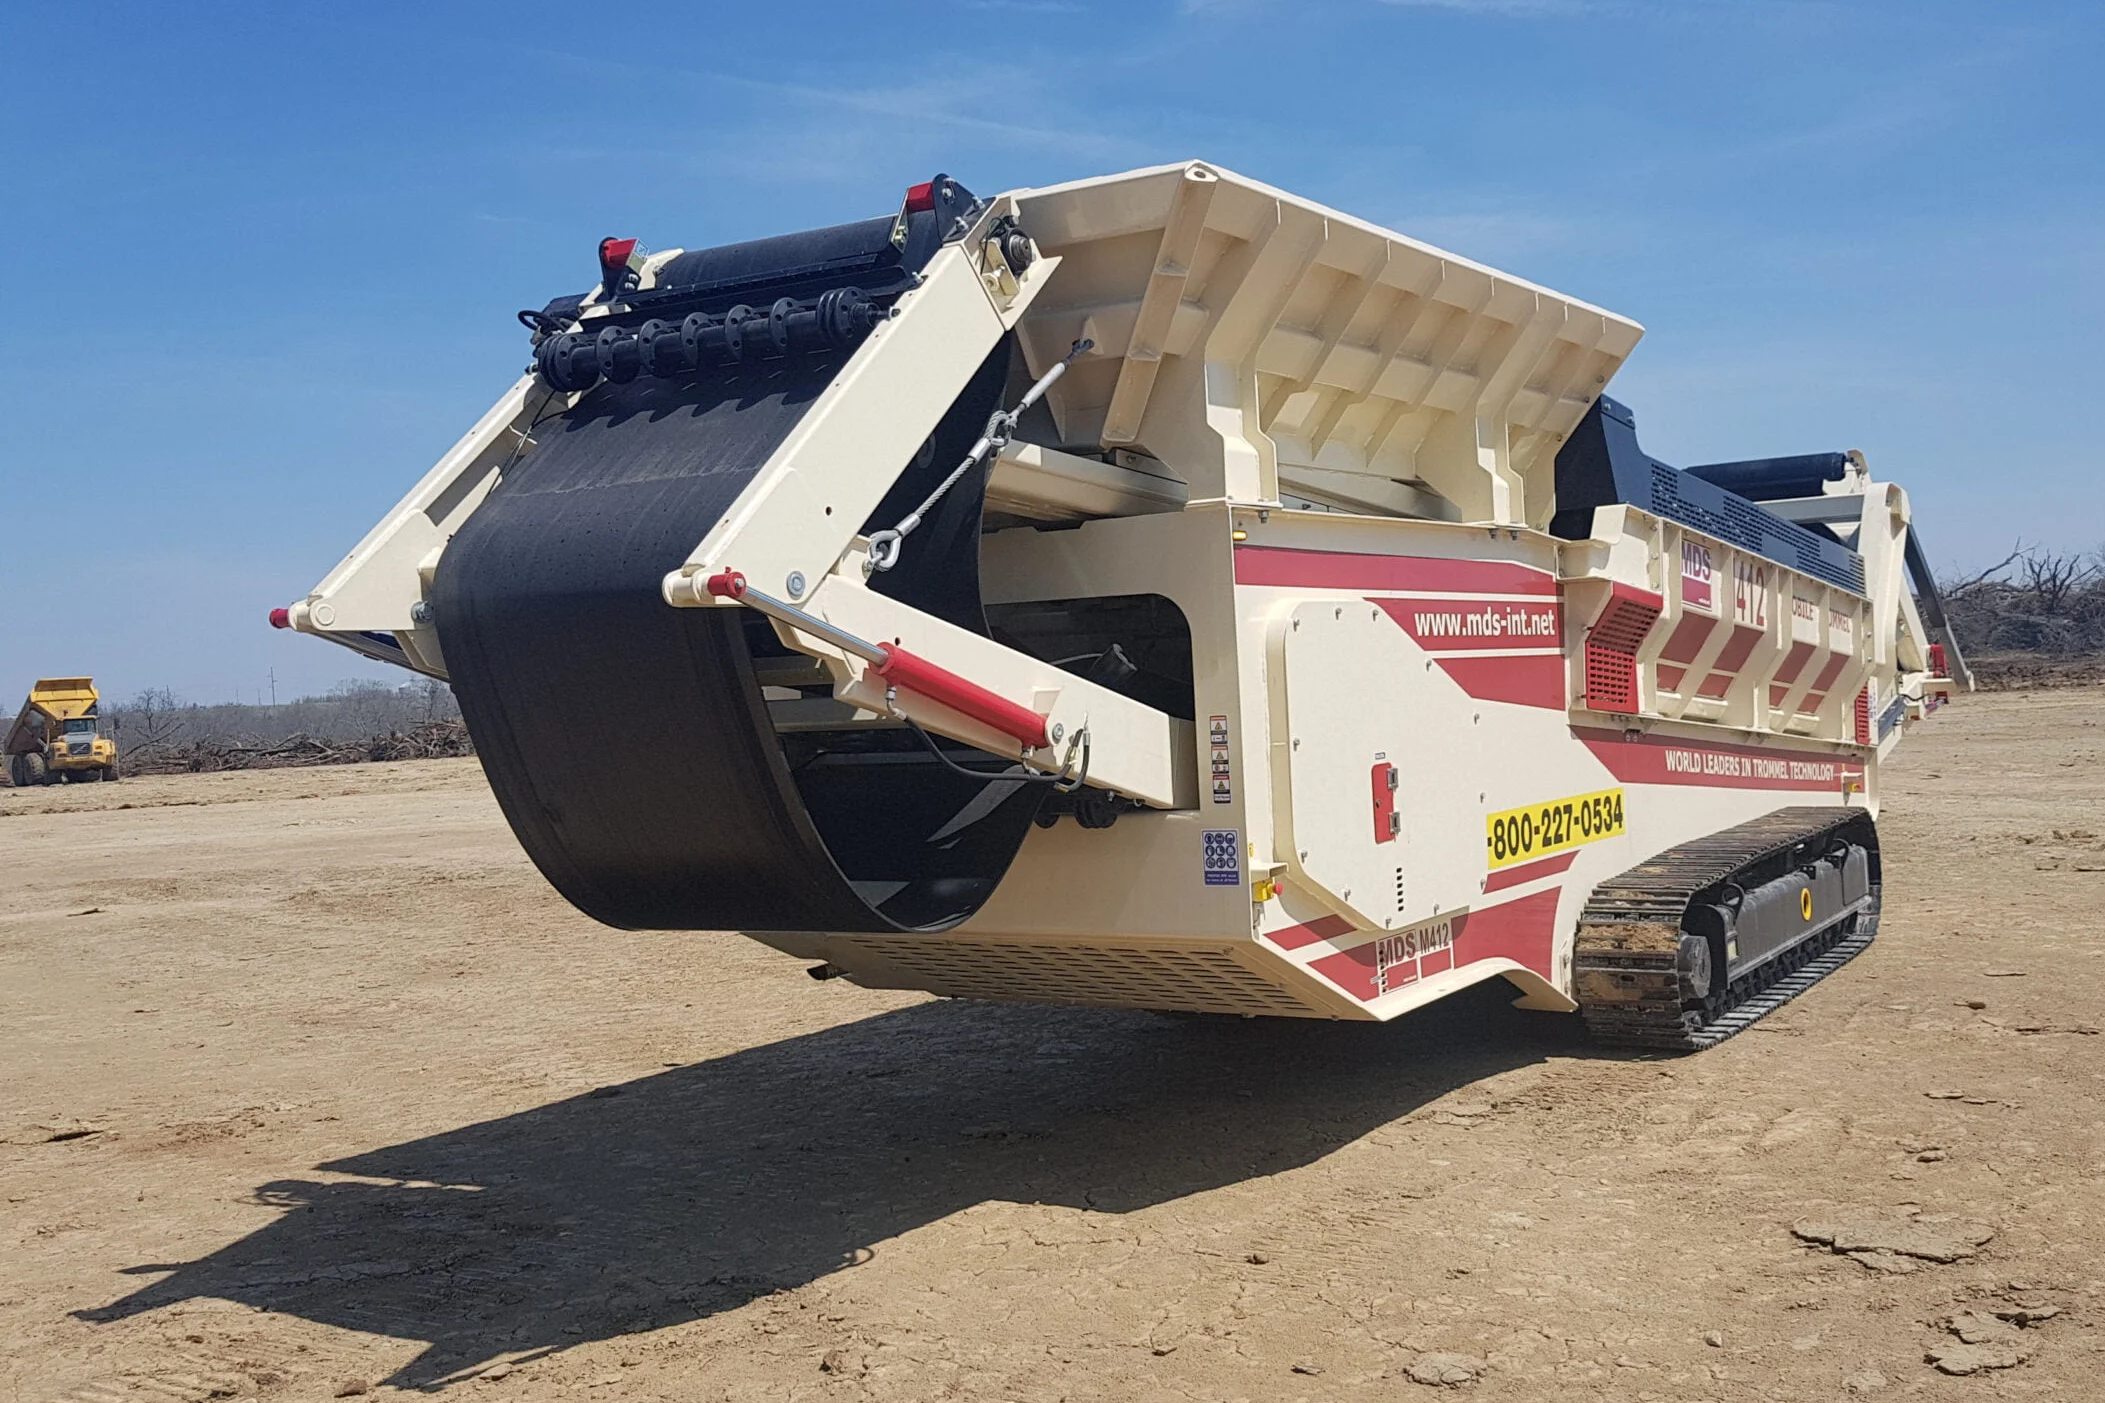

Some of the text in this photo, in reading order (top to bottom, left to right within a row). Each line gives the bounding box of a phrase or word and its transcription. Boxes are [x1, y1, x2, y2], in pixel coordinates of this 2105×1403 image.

[1682, 541, 1765, 627] MDS 412
[1414, 606, 1556, 637] www.mds-int.net
[1792, 595, 1814, 621] OBILE
[1665, 750, 1835, 781] WORLD LEADERS IN TROMMEL TECHNOLOGY
[1378, 922, 1449, 967] MDS M412
